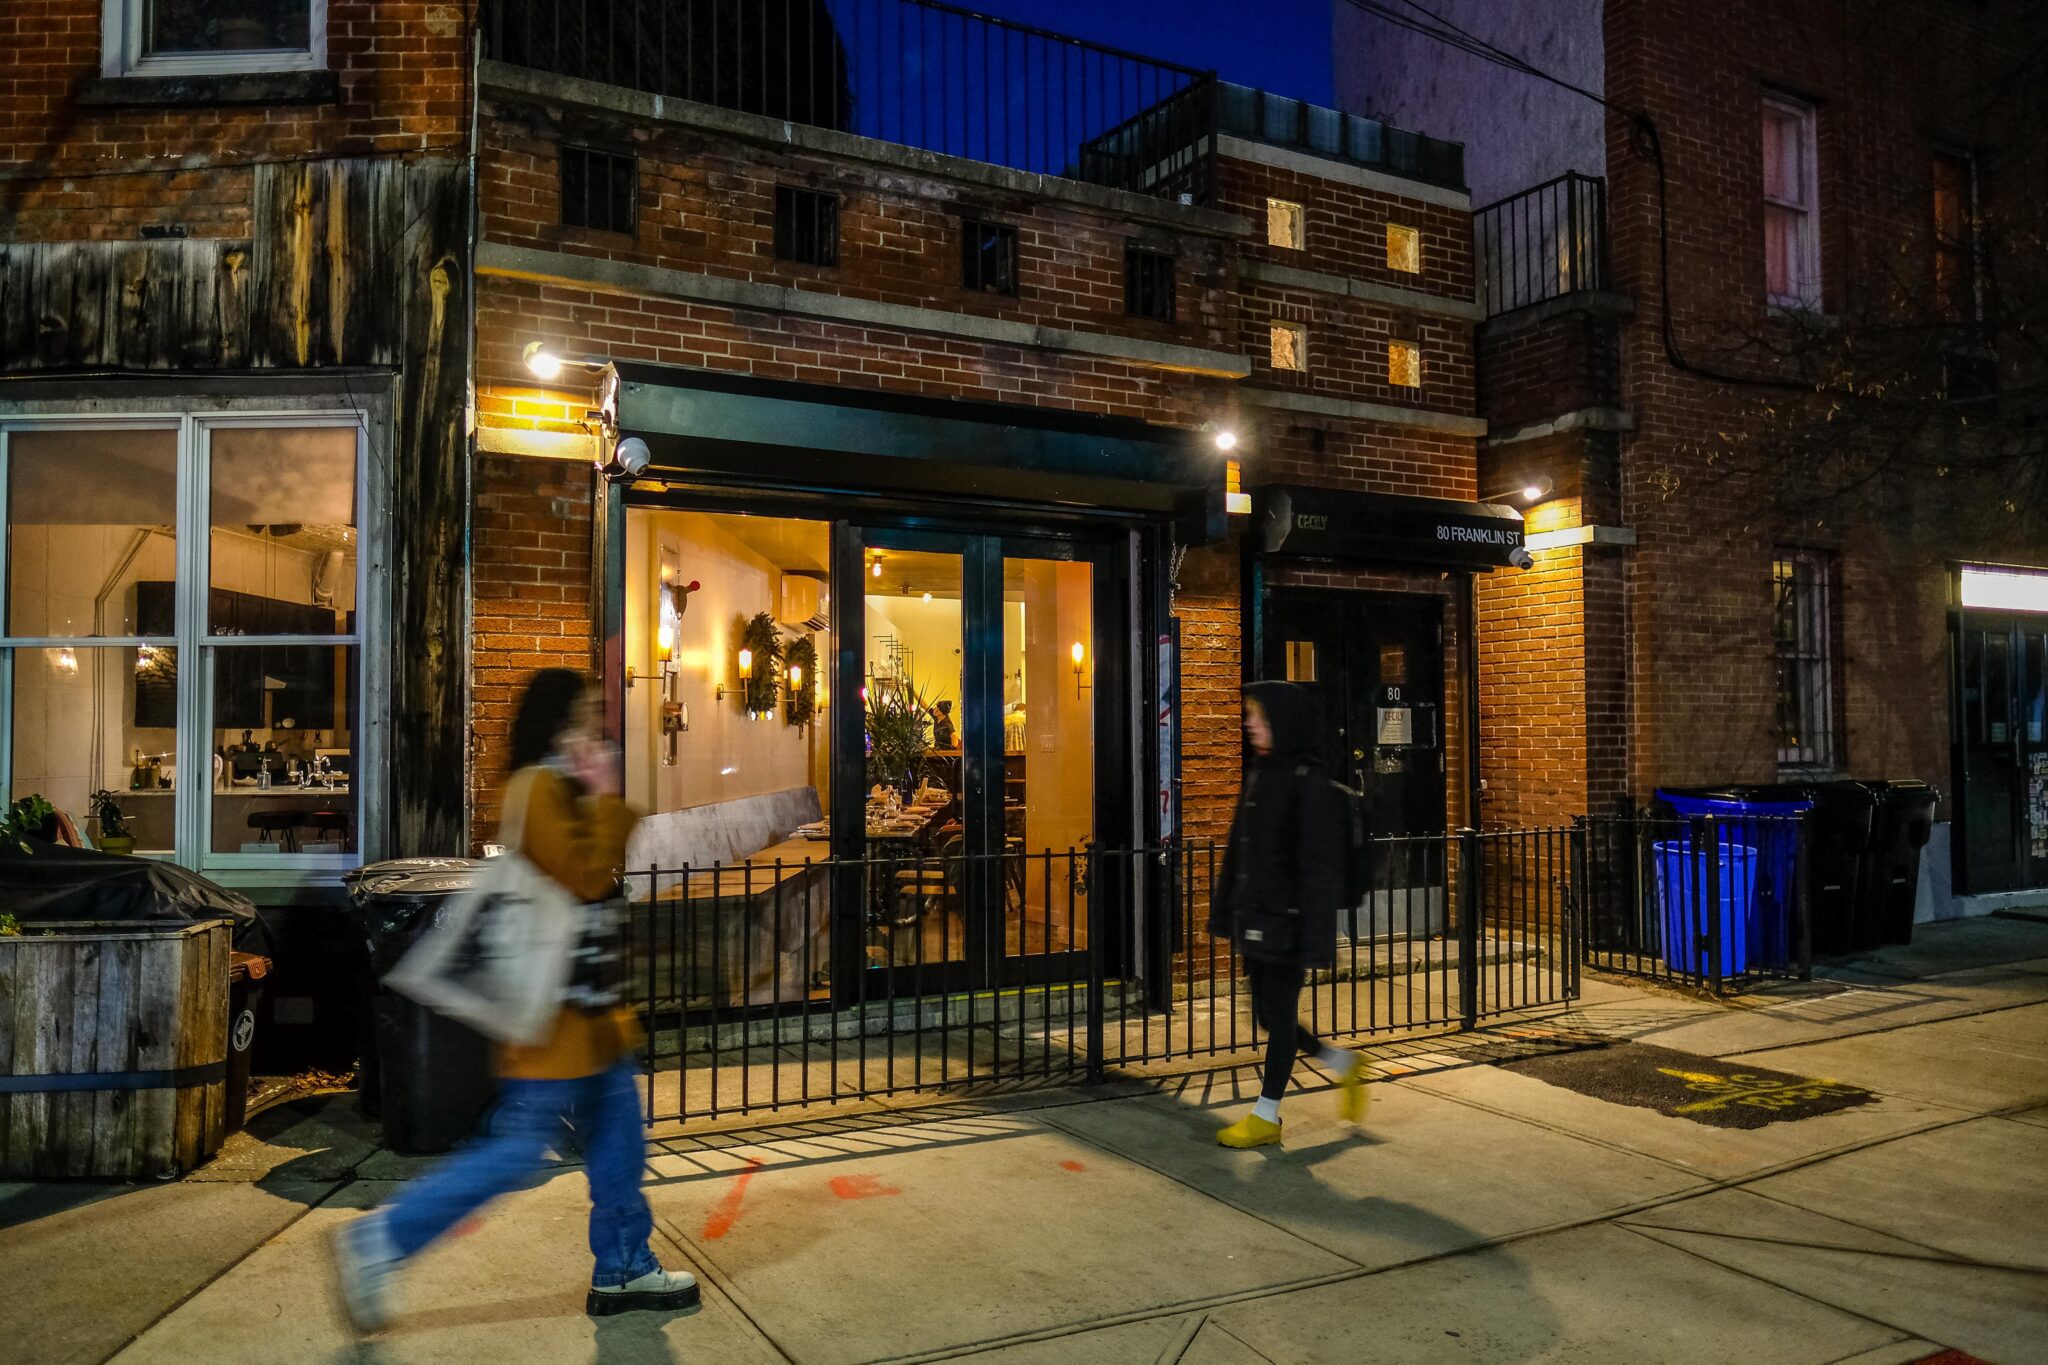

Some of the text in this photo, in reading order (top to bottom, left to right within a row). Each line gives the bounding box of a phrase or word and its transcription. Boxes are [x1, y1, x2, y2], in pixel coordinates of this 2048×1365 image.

[1436, 525, 1521, 546] 80 FRANKLIN ST
[1387, 687, 1401, 701] 80
[1384, 711, 1405, 721] CECILY
